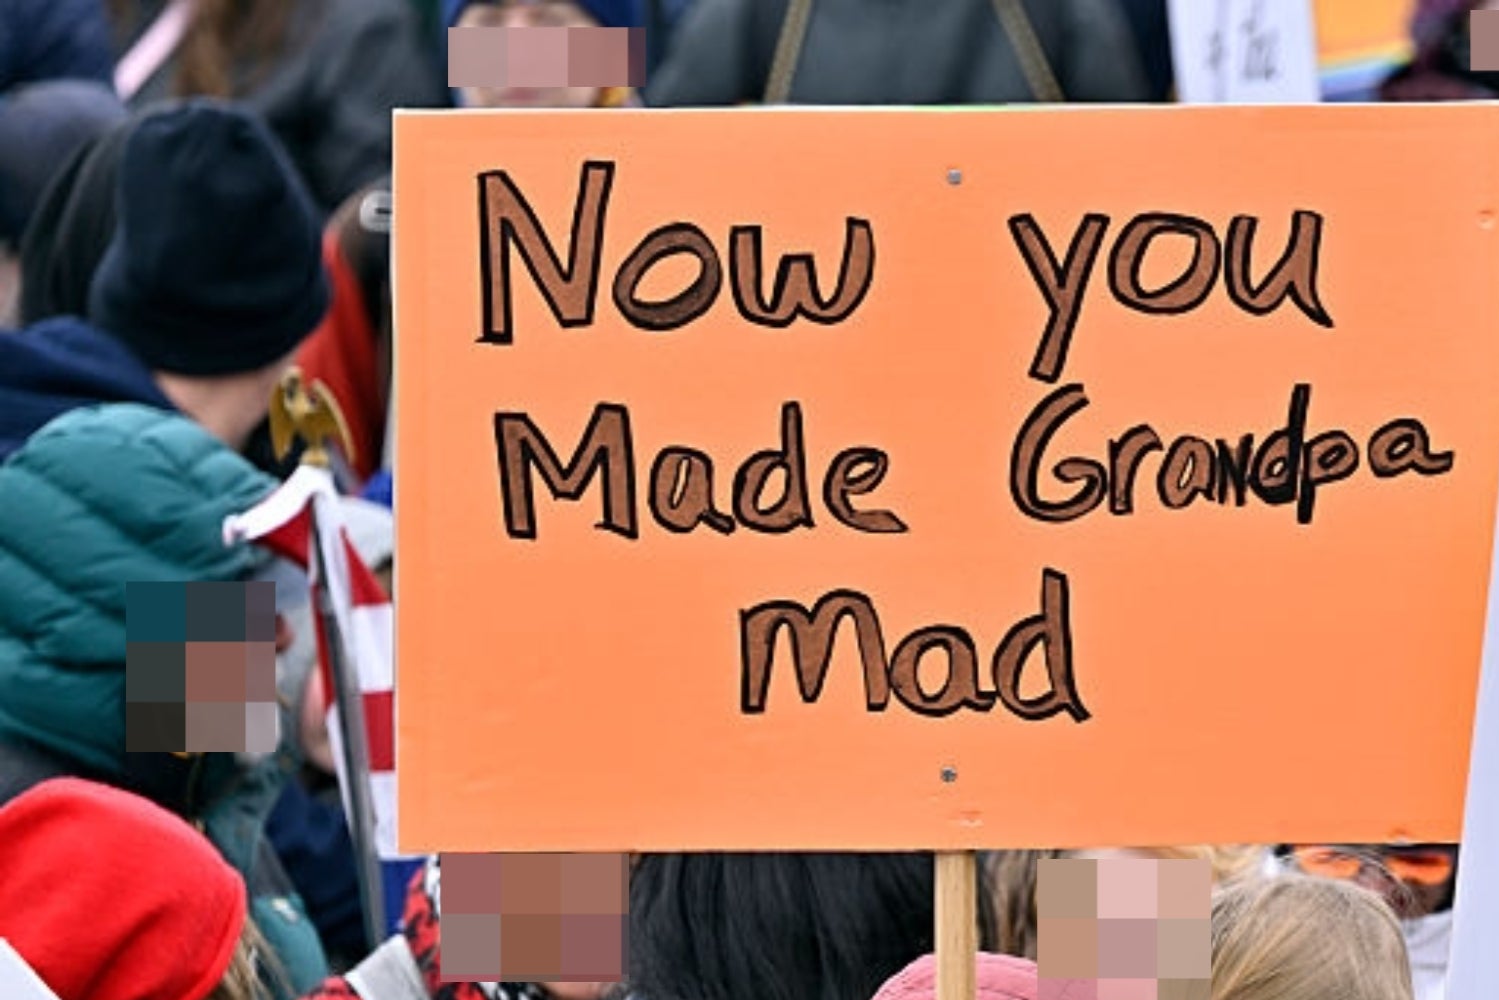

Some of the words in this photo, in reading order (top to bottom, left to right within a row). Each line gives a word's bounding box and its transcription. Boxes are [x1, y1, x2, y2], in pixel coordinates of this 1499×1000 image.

[476, 160, 876, 345] Now
[1007, 209, 1334, 383] you
[493, 400, 908, 539] Made
[1009, 383, 1455, 525] Grandpa
[739, 567, 1092, 723] Mad
